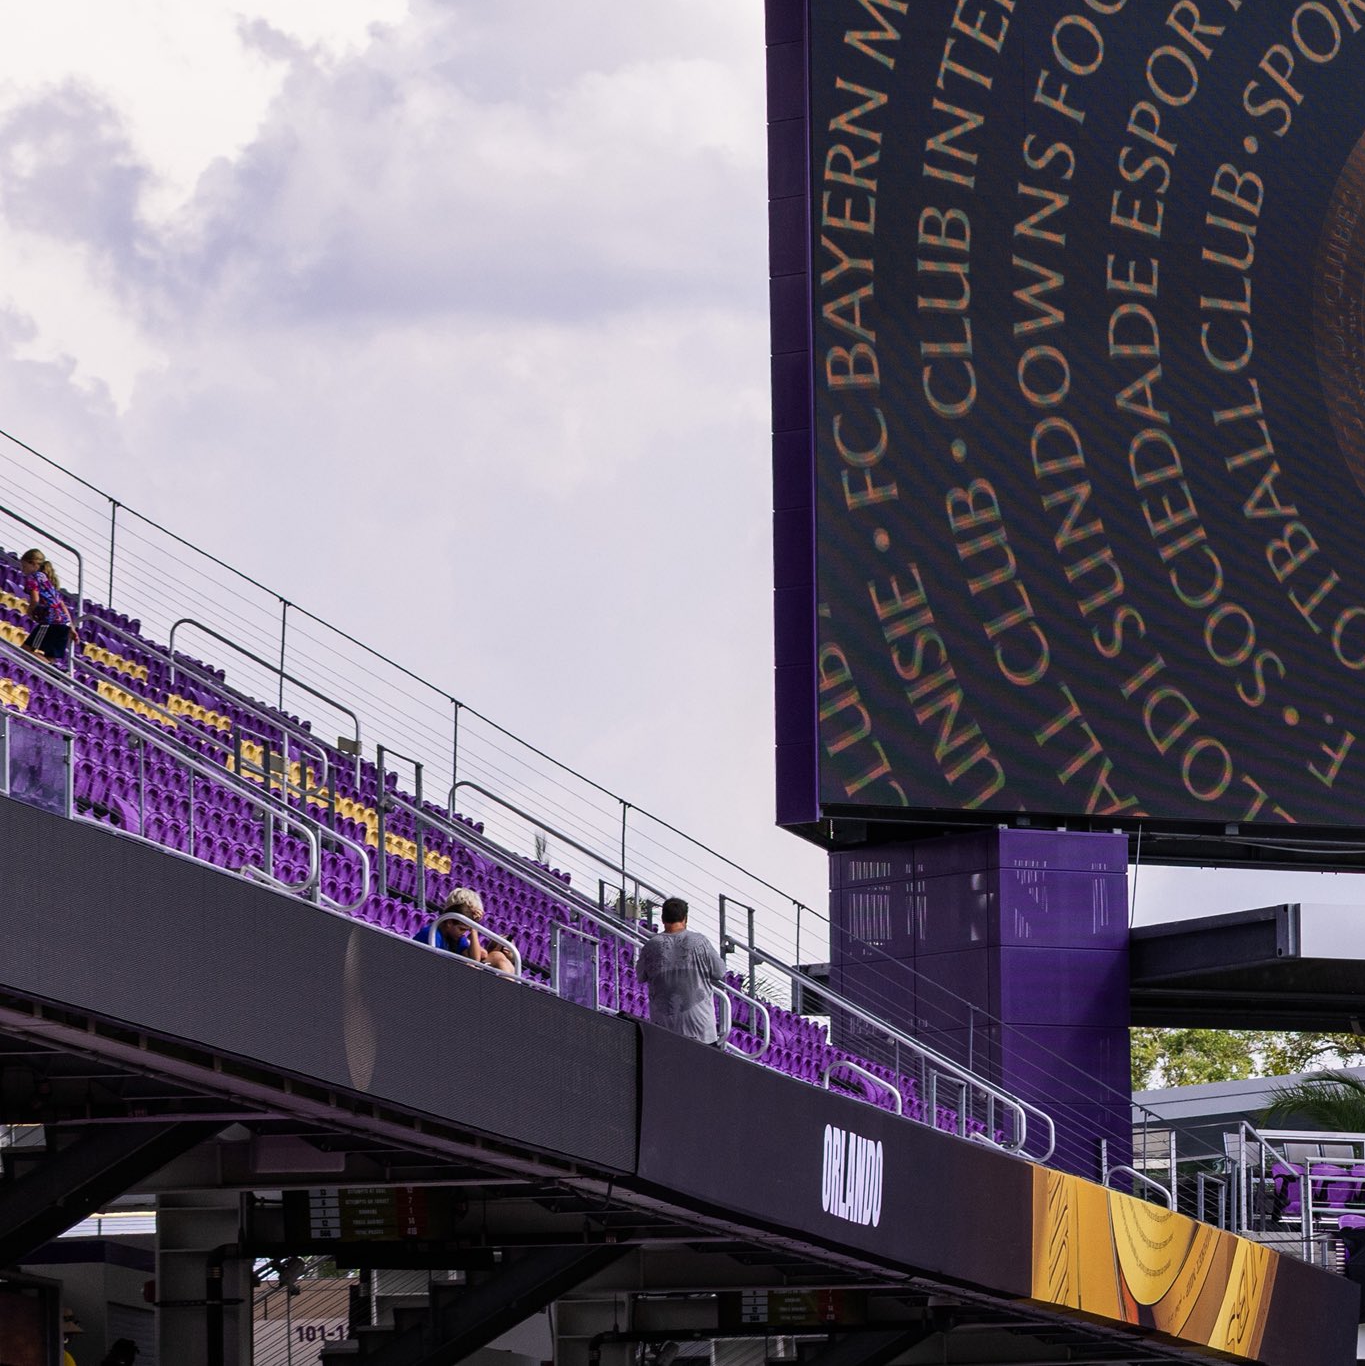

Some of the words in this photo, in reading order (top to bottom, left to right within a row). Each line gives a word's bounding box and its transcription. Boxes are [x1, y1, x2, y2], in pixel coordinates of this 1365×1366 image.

[820, 77, 889, 391] BAYERN
[917, 206, 977, 418] CLUB
[1012, 135, 1146, 658] SUNDOWNS
[1107, 252, 1286, 707] SOCIEDADE
[946, 477, 1051, 686] CLUB
[819, 642, 909, 806] LUB
[868, 563, 1026, 811] UNISIE
[1035, 681, 1150, 816] ALL
[1121, 653, 1298, 823] LODI
[822, 1123, 883, 1227] ORLANDO
